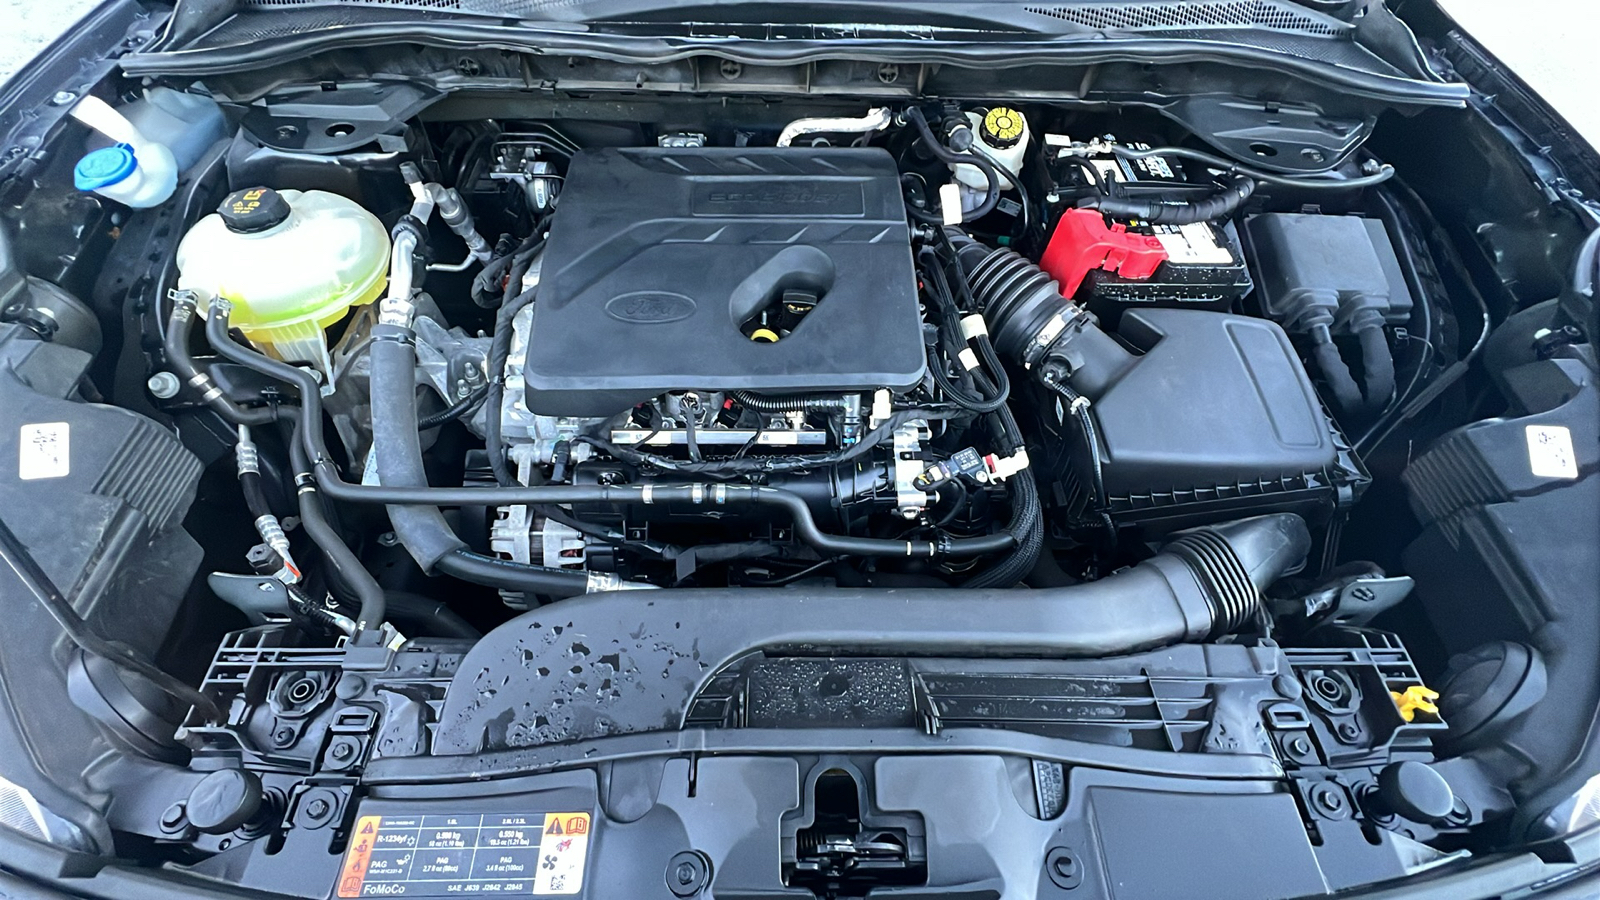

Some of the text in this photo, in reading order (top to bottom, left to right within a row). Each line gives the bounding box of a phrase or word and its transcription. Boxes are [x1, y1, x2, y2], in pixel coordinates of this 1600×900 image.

[377, 834, 408, 844] R-1234yf
[371, 860, 388, 868] PAG
[363, 884, 405, 895] FoMoCo
[447, 884, 462, 892] SAE
